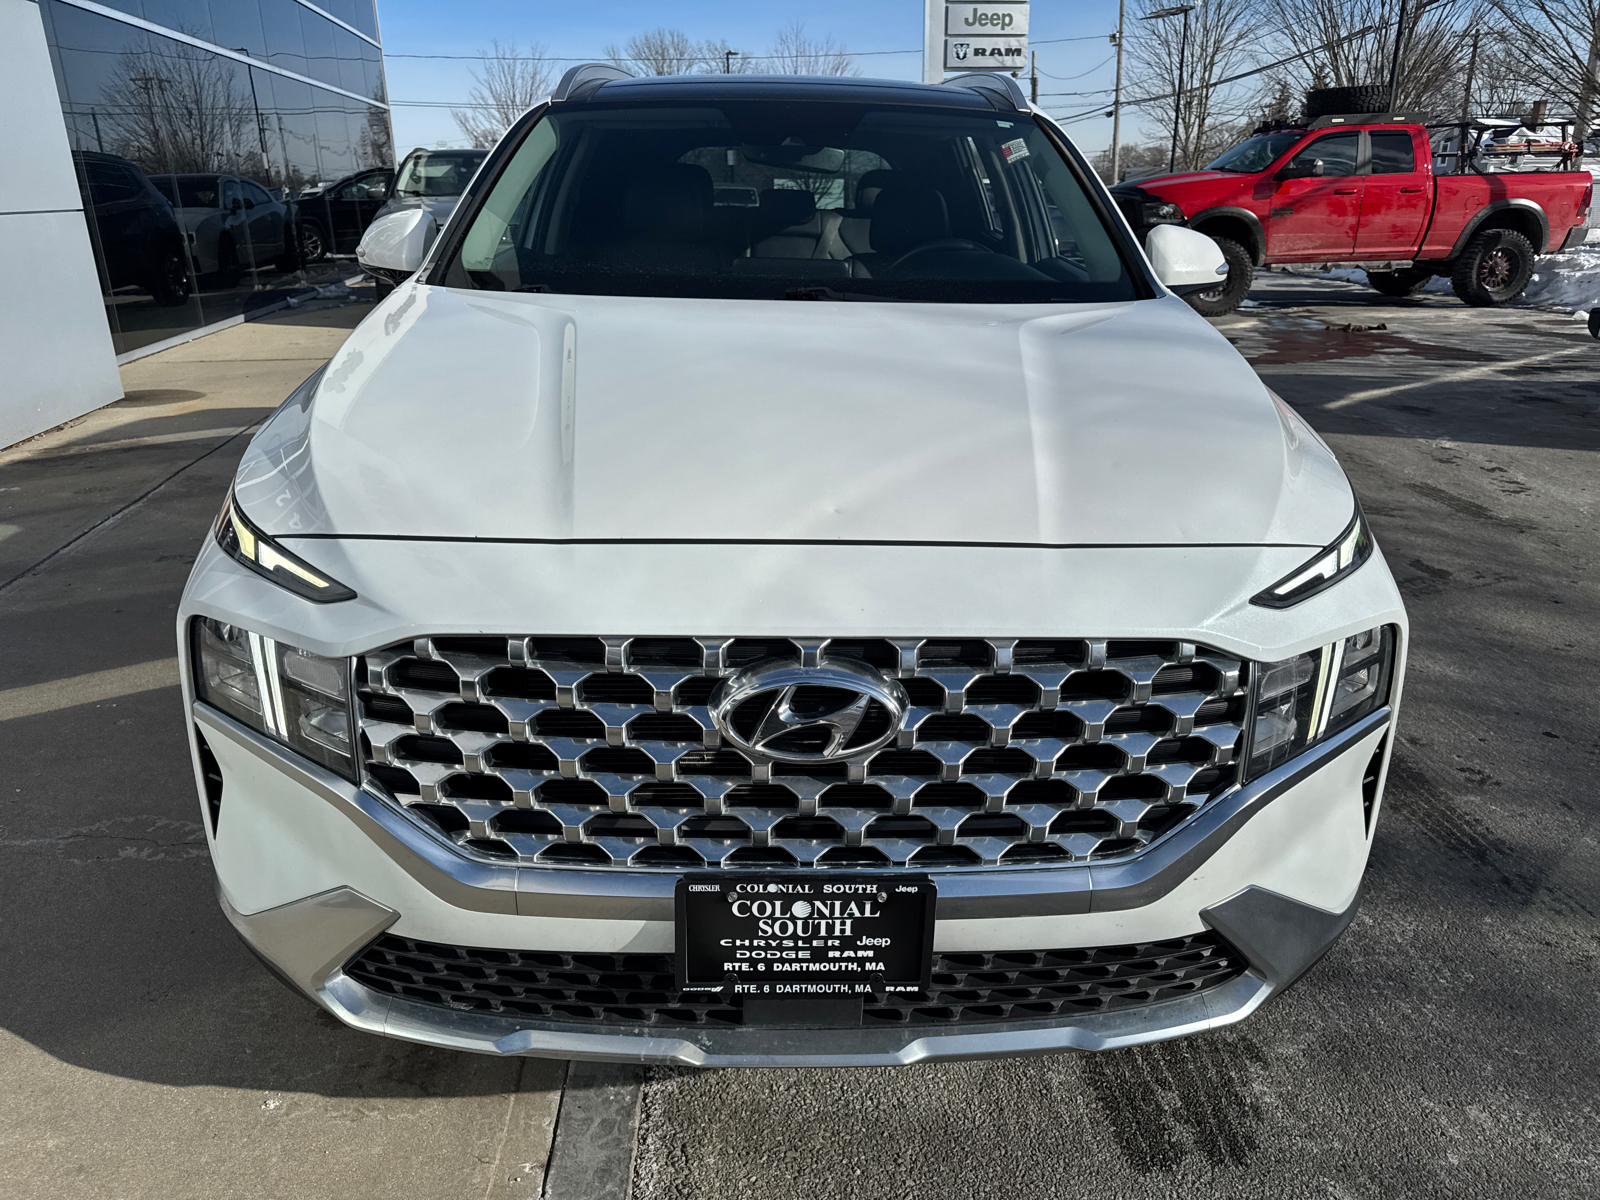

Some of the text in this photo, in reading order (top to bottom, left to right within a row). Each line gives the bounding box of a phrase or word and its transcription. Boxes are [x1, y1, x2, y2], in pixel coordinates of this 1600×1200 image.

[964, 8, 1013, 30] Jeep
[973, 48, 1022, 56] RAM
[688, 884, 721, 892] CHRYSLER
[736, 883, 878, 893] COLONIAL SOUTH
[895, 885, 918, 893] Jeep
[732, 900, 880, 918] COLONIAL
[758, 919, 854, 937] SOUTH
[720, 936, 891, 947] CHRYSLER Jeep
[736, 950, 811, 958] DODGE
[723, 962, 885, 972] RTE. 6 DARTMOUTH, MA
[734, 985, 872, 994] RTE. 6 DARTMOUTH, MA
